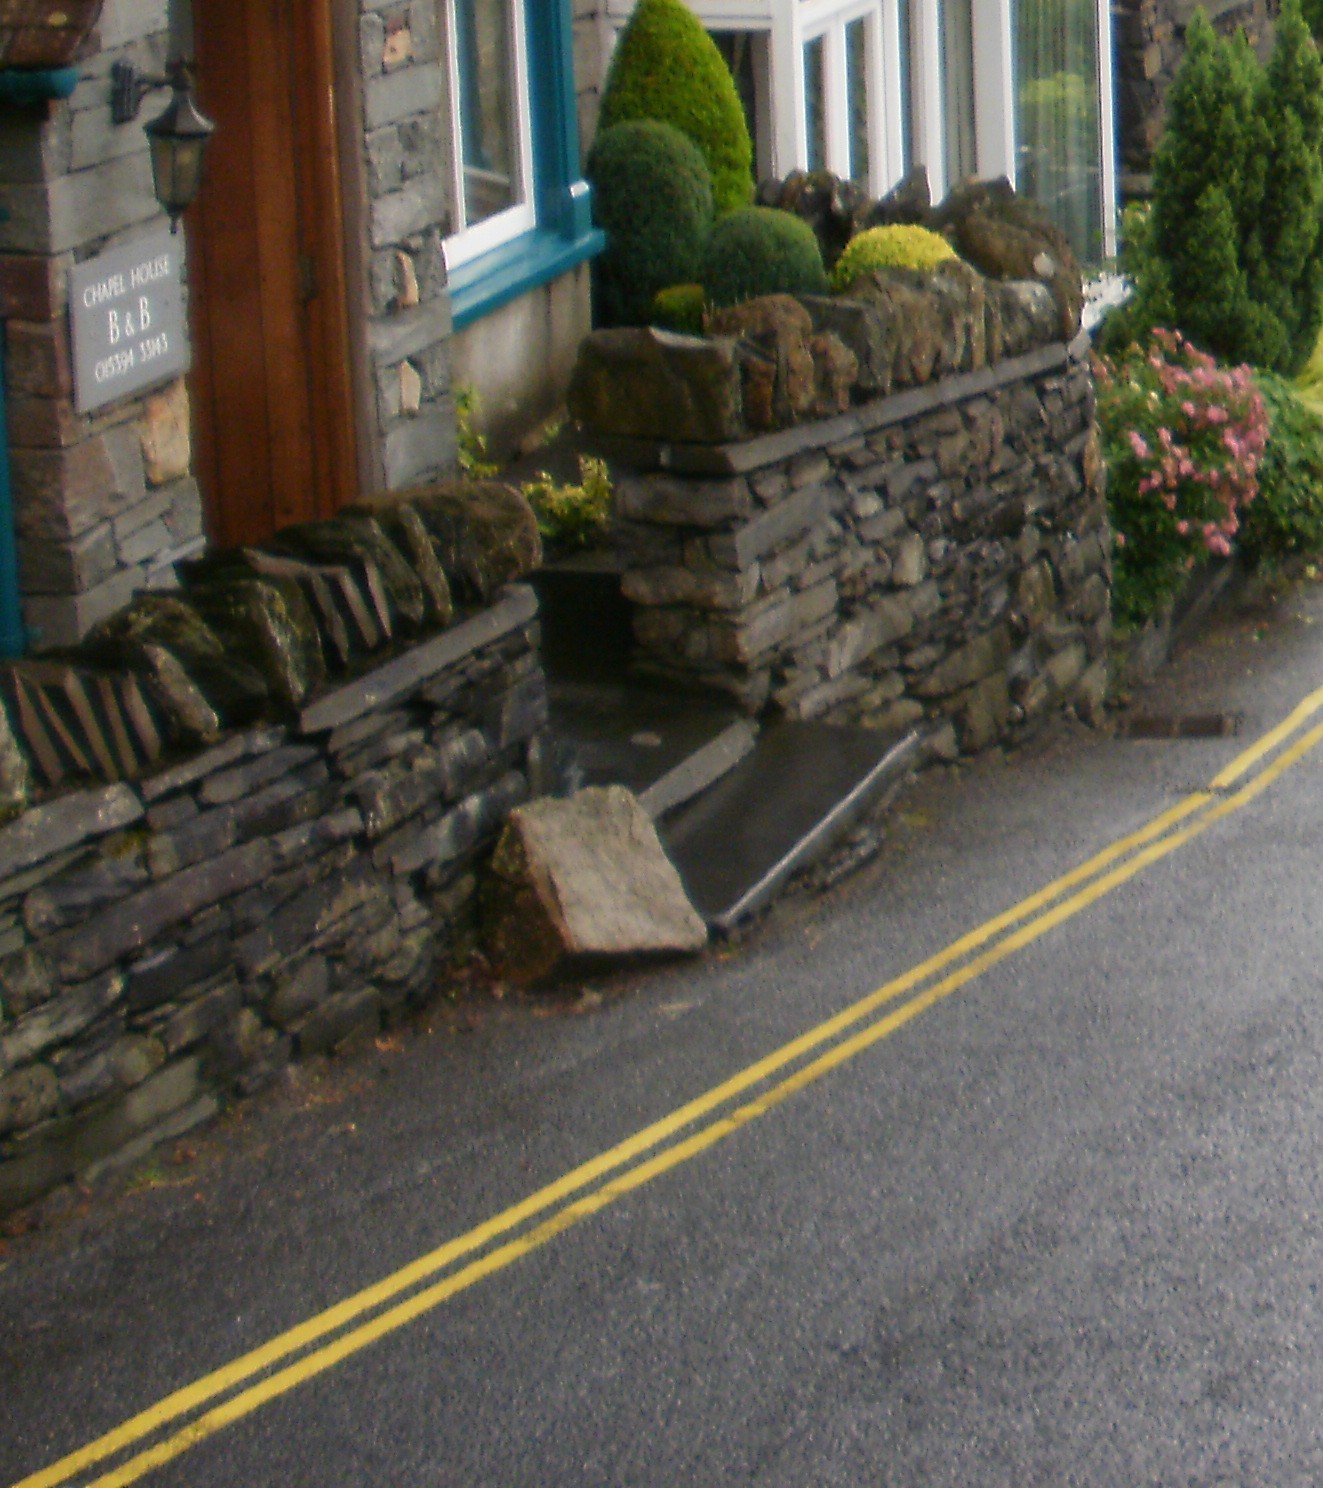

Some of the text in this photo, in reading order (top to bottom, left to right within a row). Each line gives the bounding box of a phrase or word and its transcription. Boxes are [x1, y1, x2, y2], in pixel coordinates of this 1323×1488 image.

[83, 254, 168, 308] CHAPEL HOUSE
[109, 296, 150, 344] B & B
